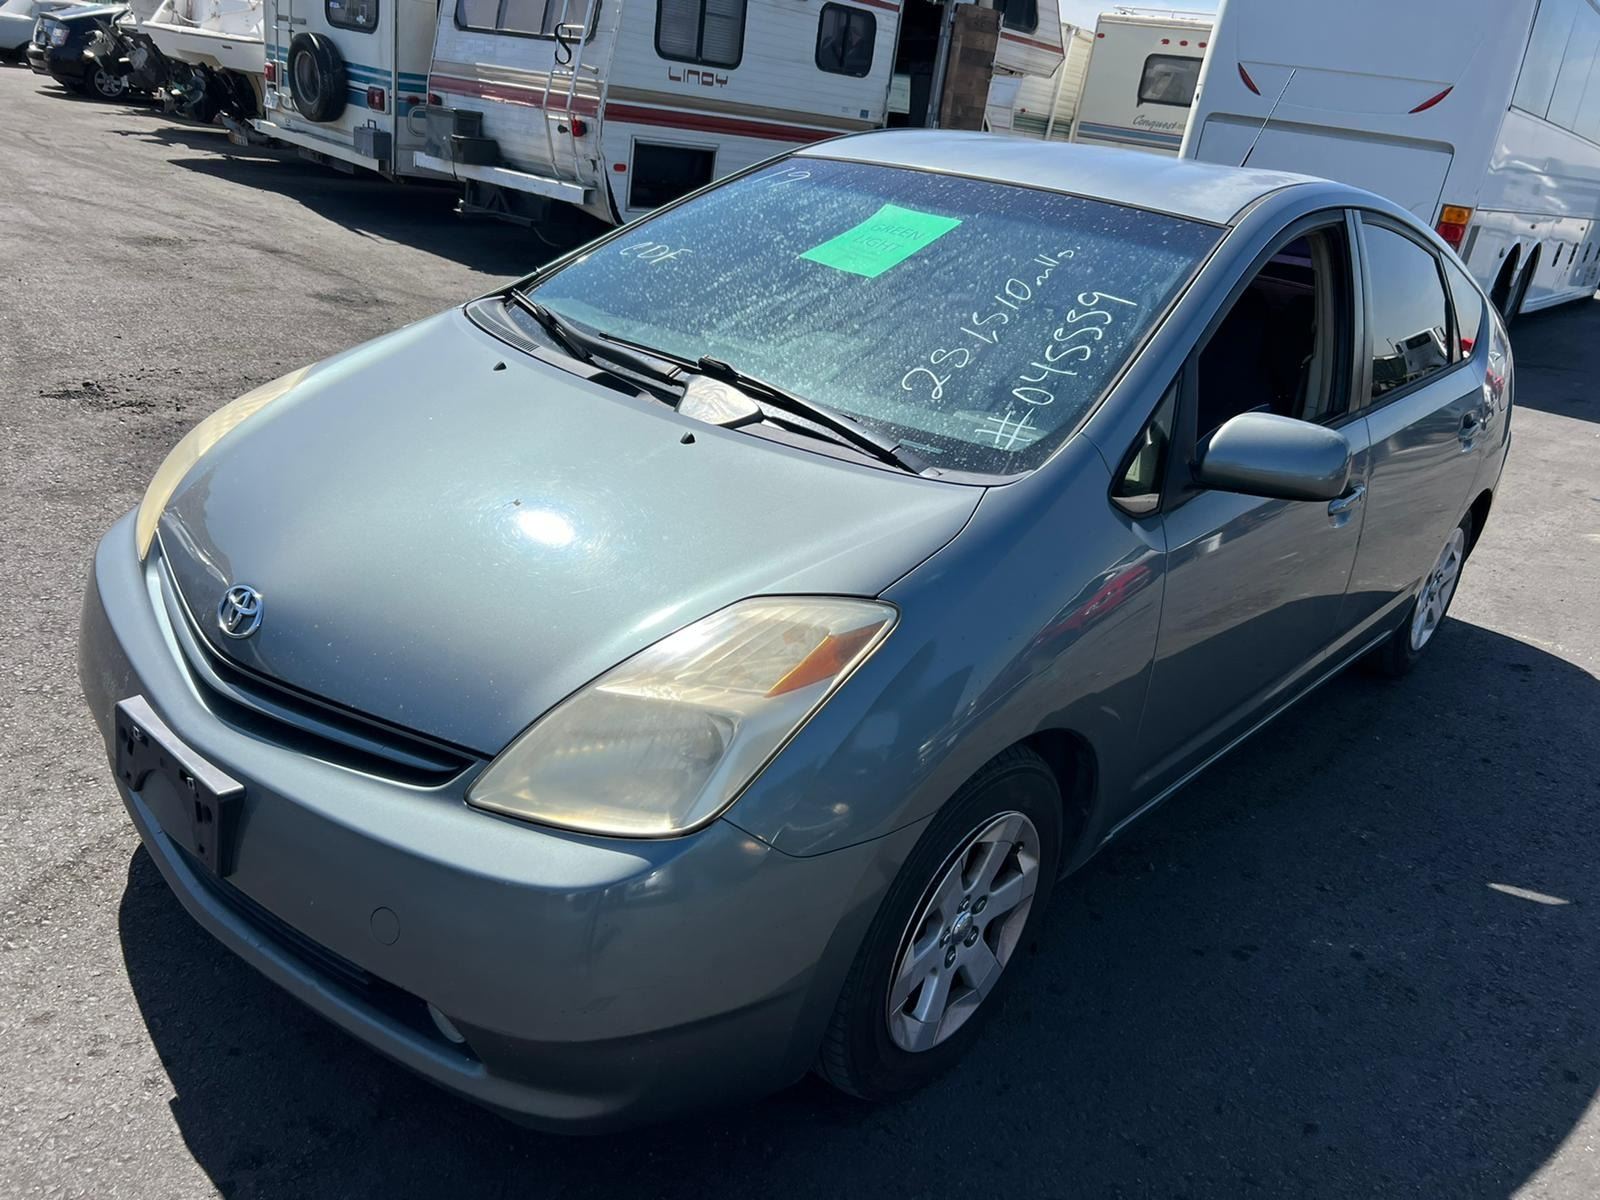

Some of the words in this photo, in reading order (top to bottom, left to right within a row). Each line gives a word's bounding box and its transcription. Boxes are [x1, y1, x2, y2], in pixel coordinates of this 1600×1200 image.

[668, 66, 729, 88] LINDY
[1132, 114, 1178, 130] Conquest
[870, 223, 926, 241] GREEN
[853, 234, 905, 252] LIGHT
